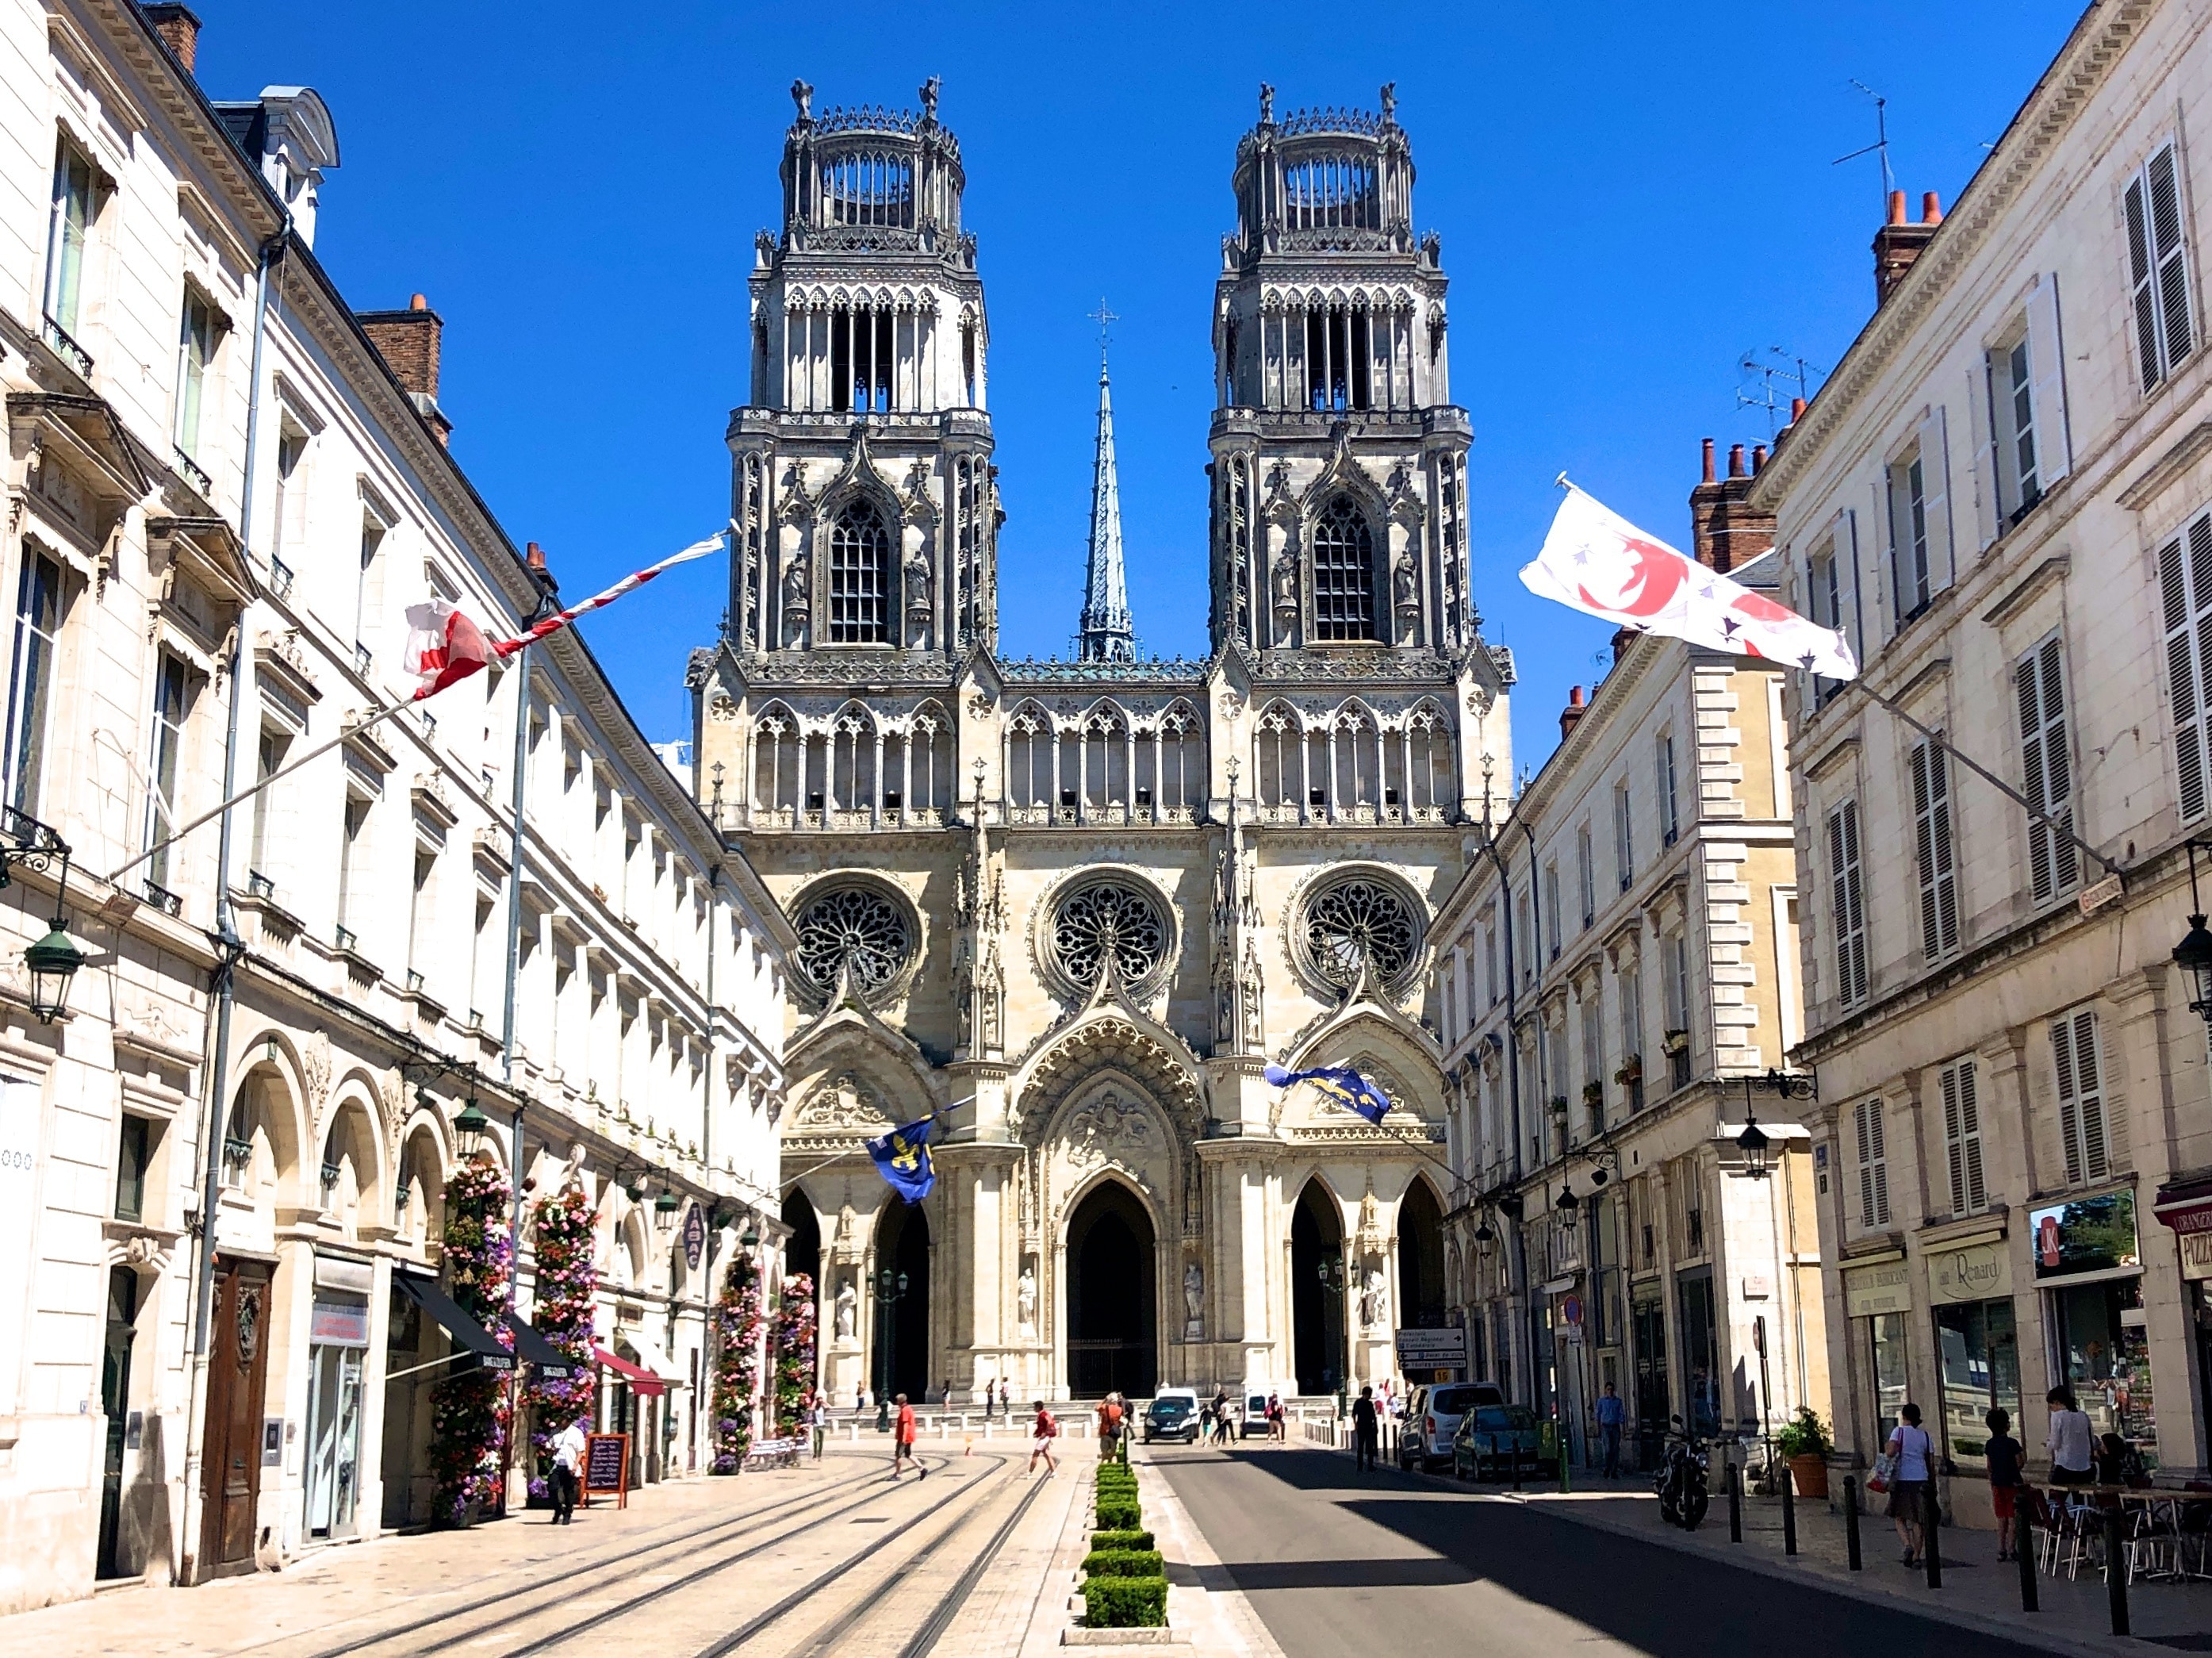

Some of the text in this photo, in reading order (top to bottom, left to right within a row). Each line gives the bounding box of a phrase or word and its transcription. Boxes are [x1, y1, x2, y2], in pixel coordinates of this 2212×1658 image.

[688, 1207, 701, 1265] TABAC
[2042, 1227, 2058, 1253] JK
[1957, 1253, 1998, 1291] Renard
